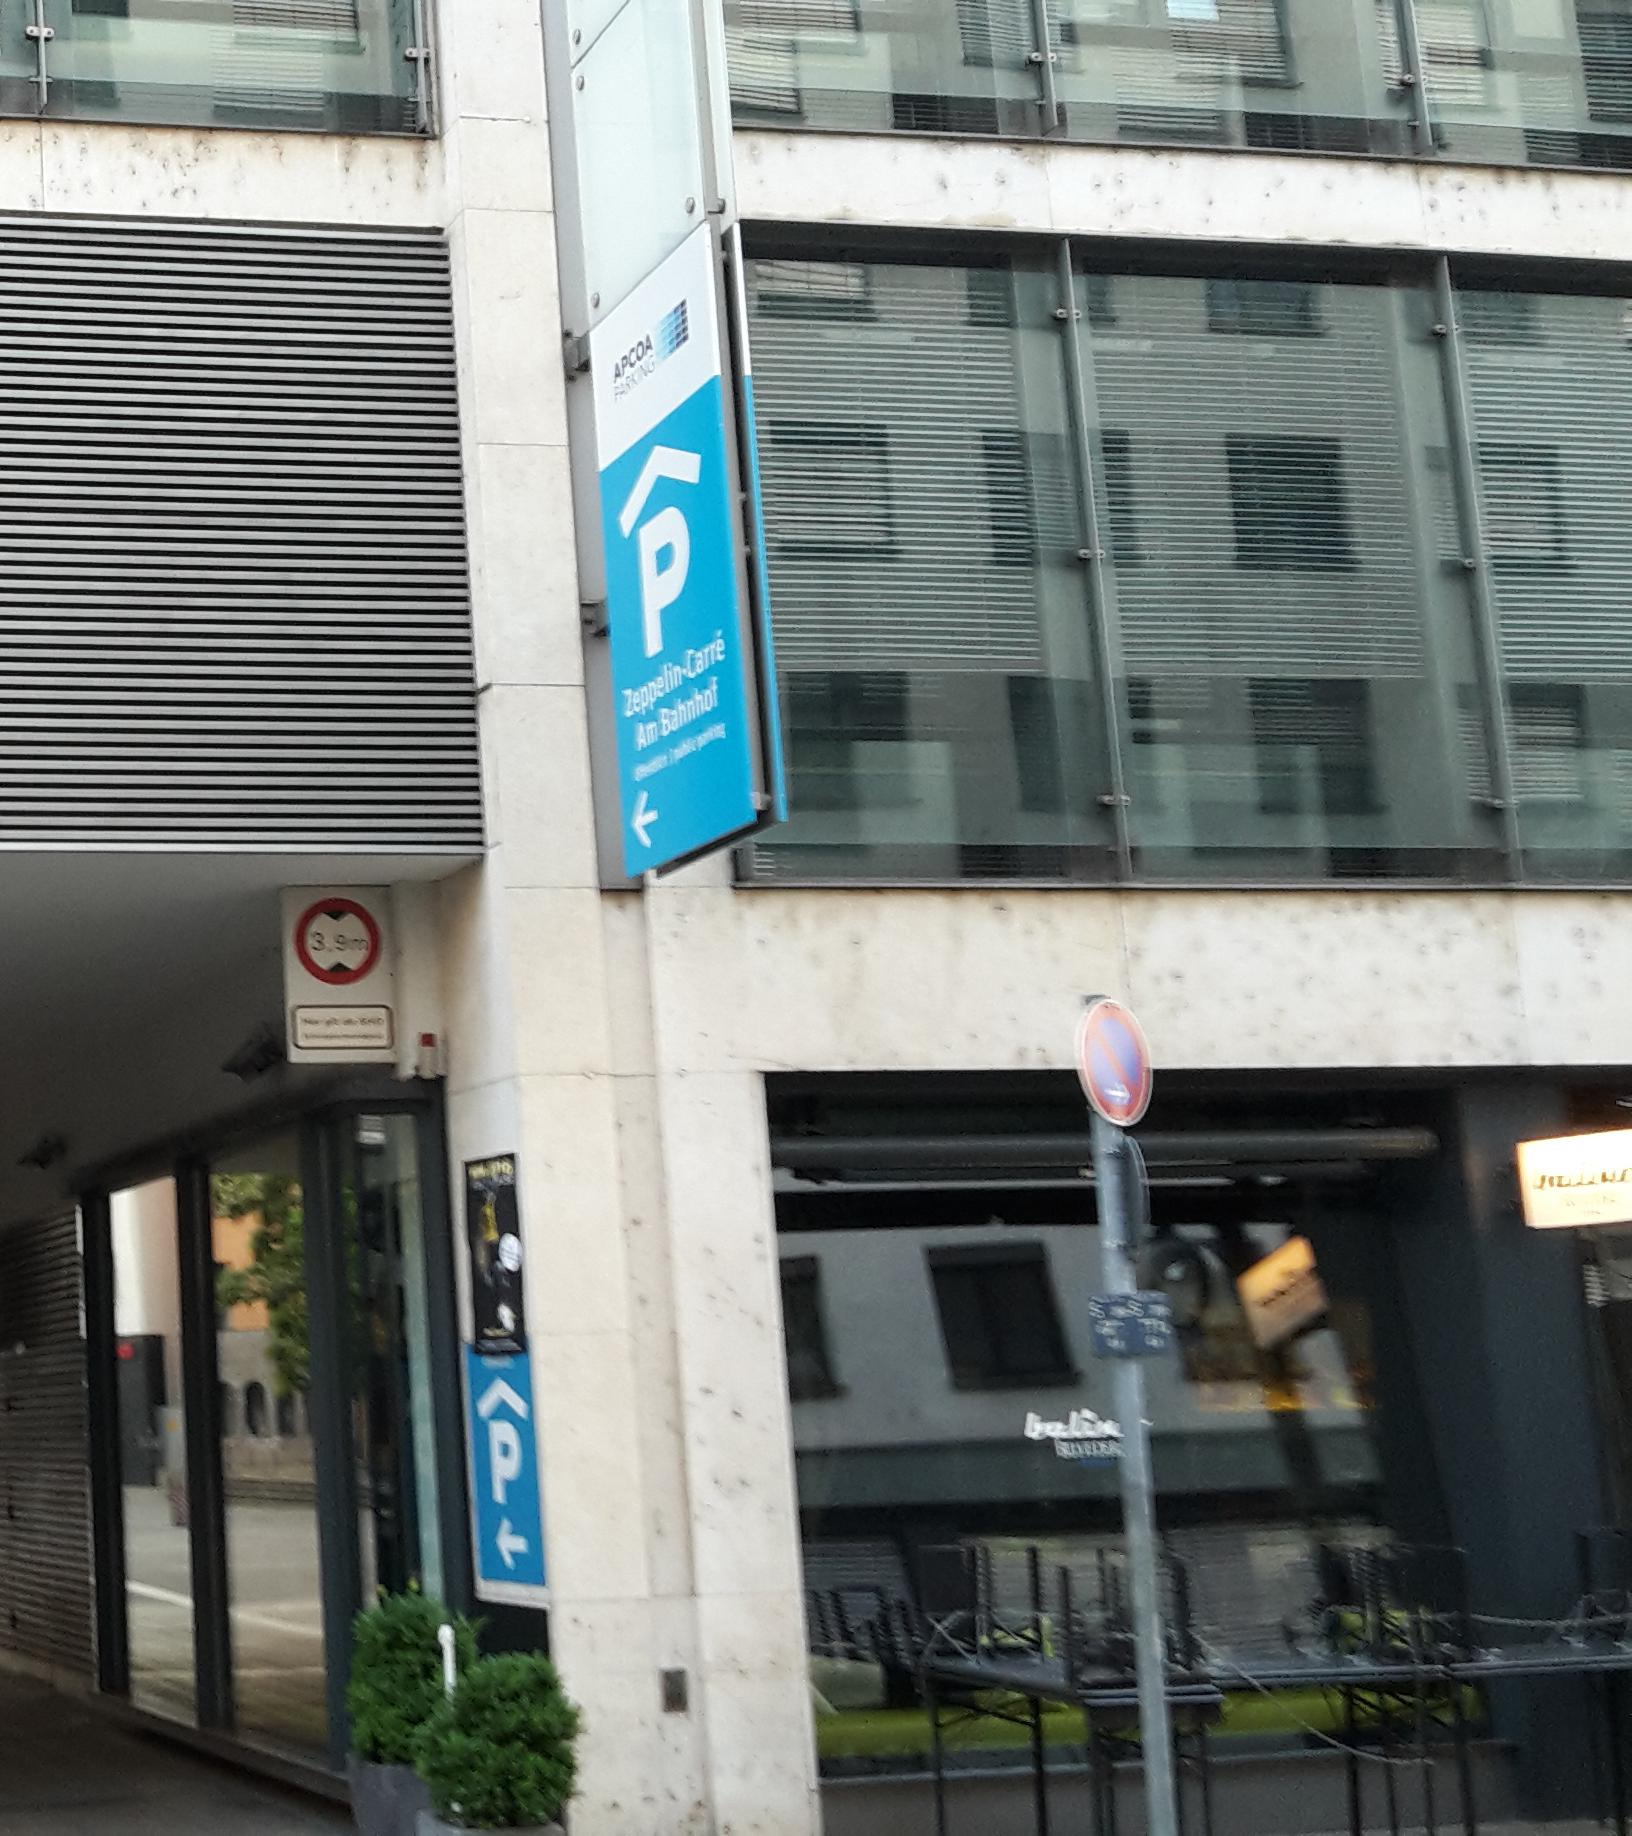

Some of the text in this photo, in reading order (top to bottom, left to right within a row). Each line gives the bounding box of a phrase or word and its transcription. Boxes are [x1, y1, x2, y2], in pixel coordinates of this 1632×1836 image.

[613, 333, 653, 383] APCOA
[638, 506, 690, 659] P
[621, 629, 726, 717] Zeppelin-Carré
[636, 676, 718, 751] Am Bahnhof
[488, 1419, 522, 1504] P
